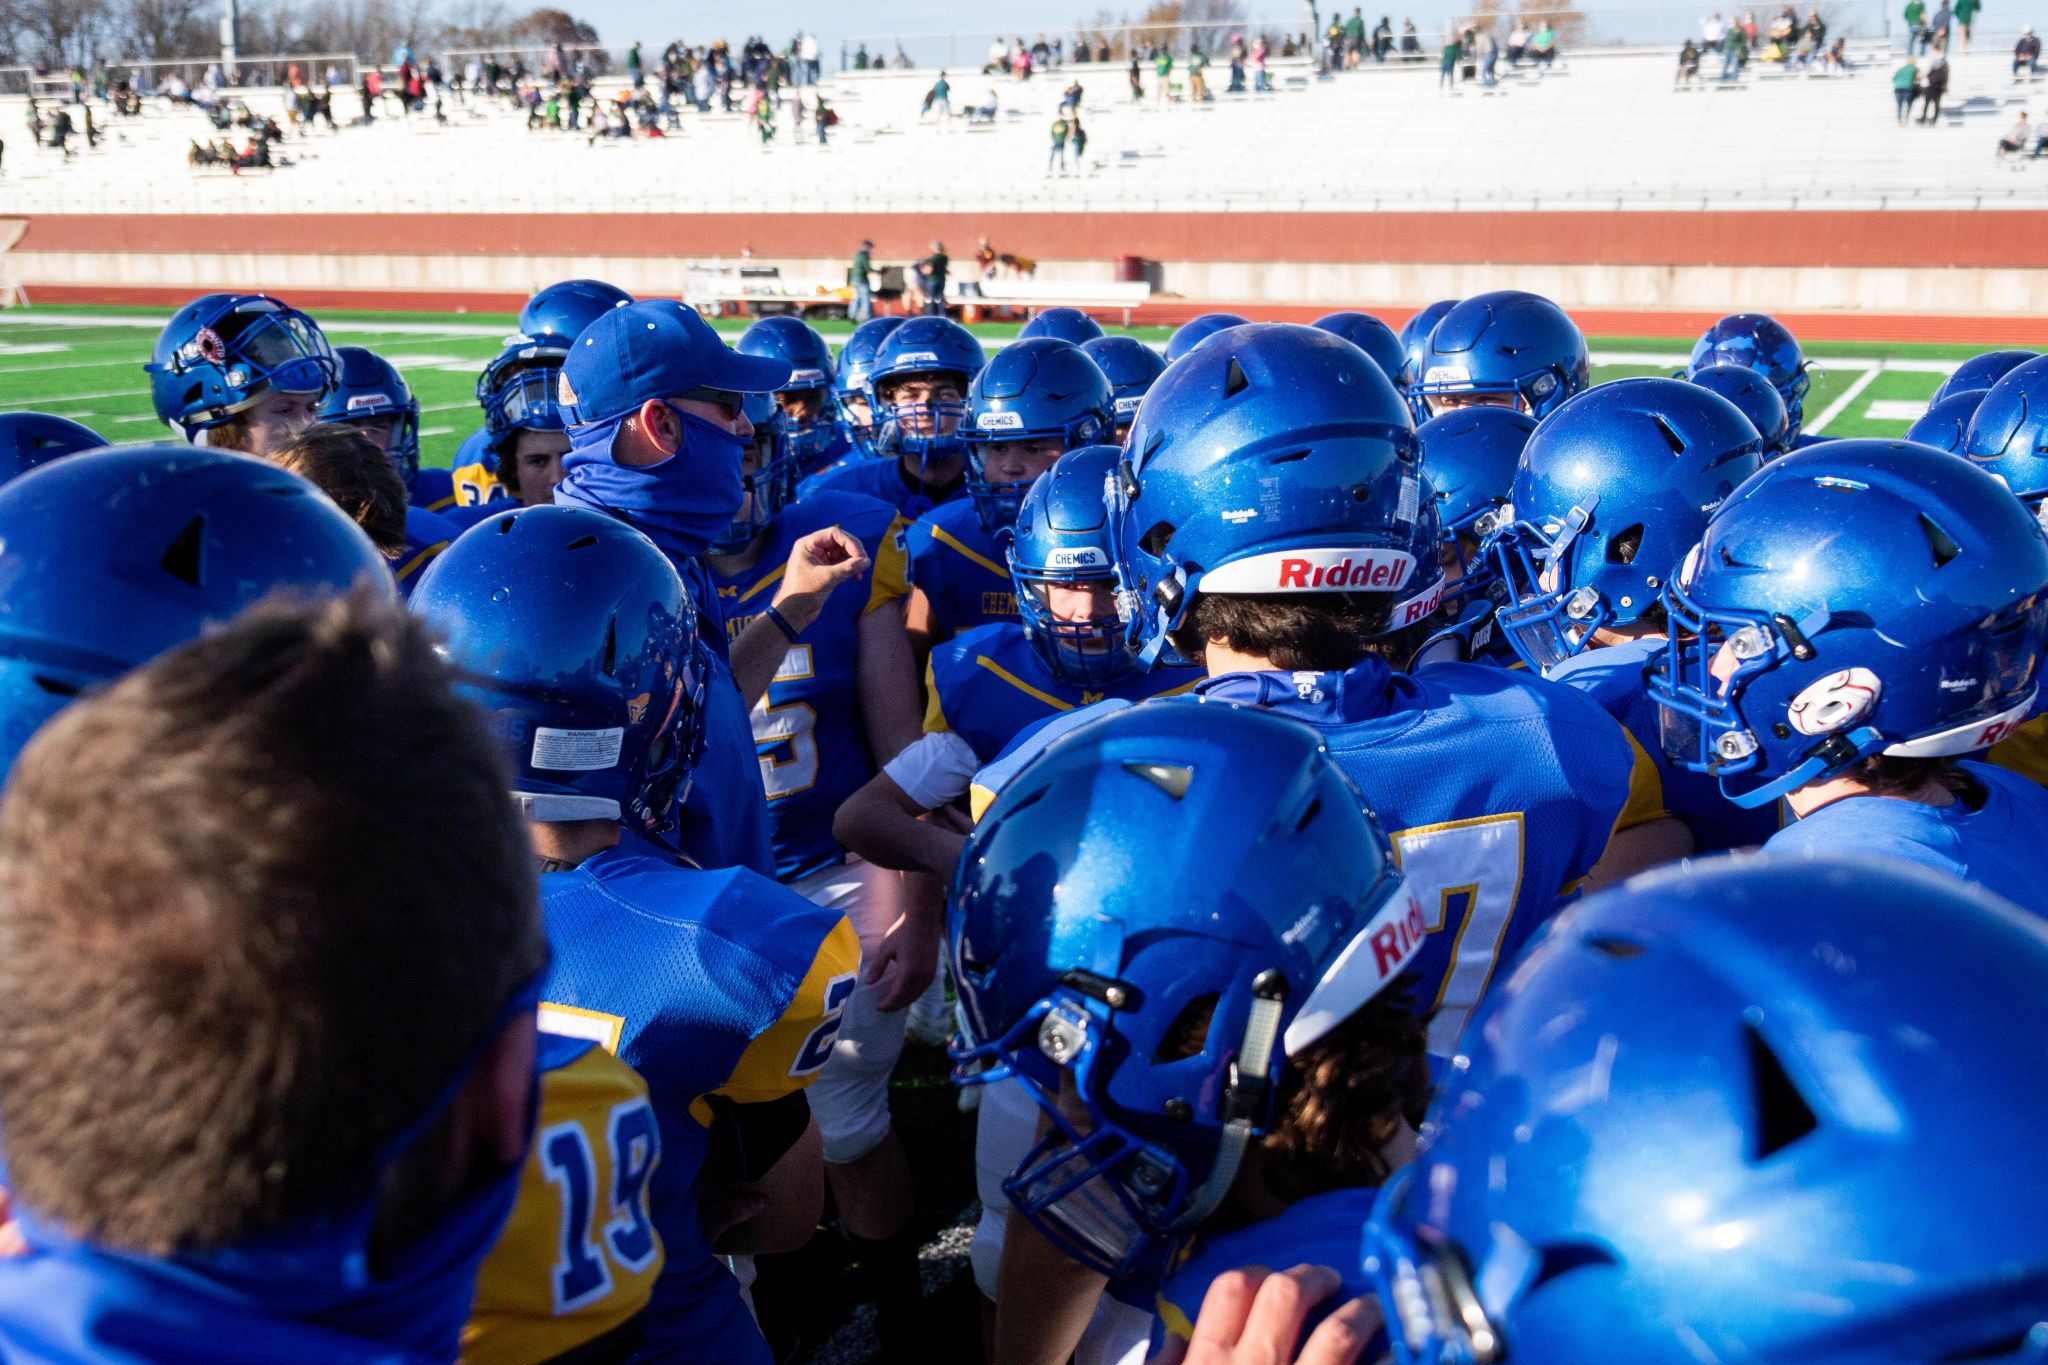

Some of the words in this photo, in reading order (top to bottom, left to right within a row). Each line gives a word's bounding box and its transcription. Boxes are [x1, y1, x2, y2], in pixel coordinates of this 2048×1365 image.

[983, 415, 1014, 426] CHEMICS
[1055, 552, 1096, 564] CHEMICS
[1278, 558, 1407, 588] Riddell
[982, 591, 1019, 615] CHEM
[538, 1095, 663, 1316] 19
